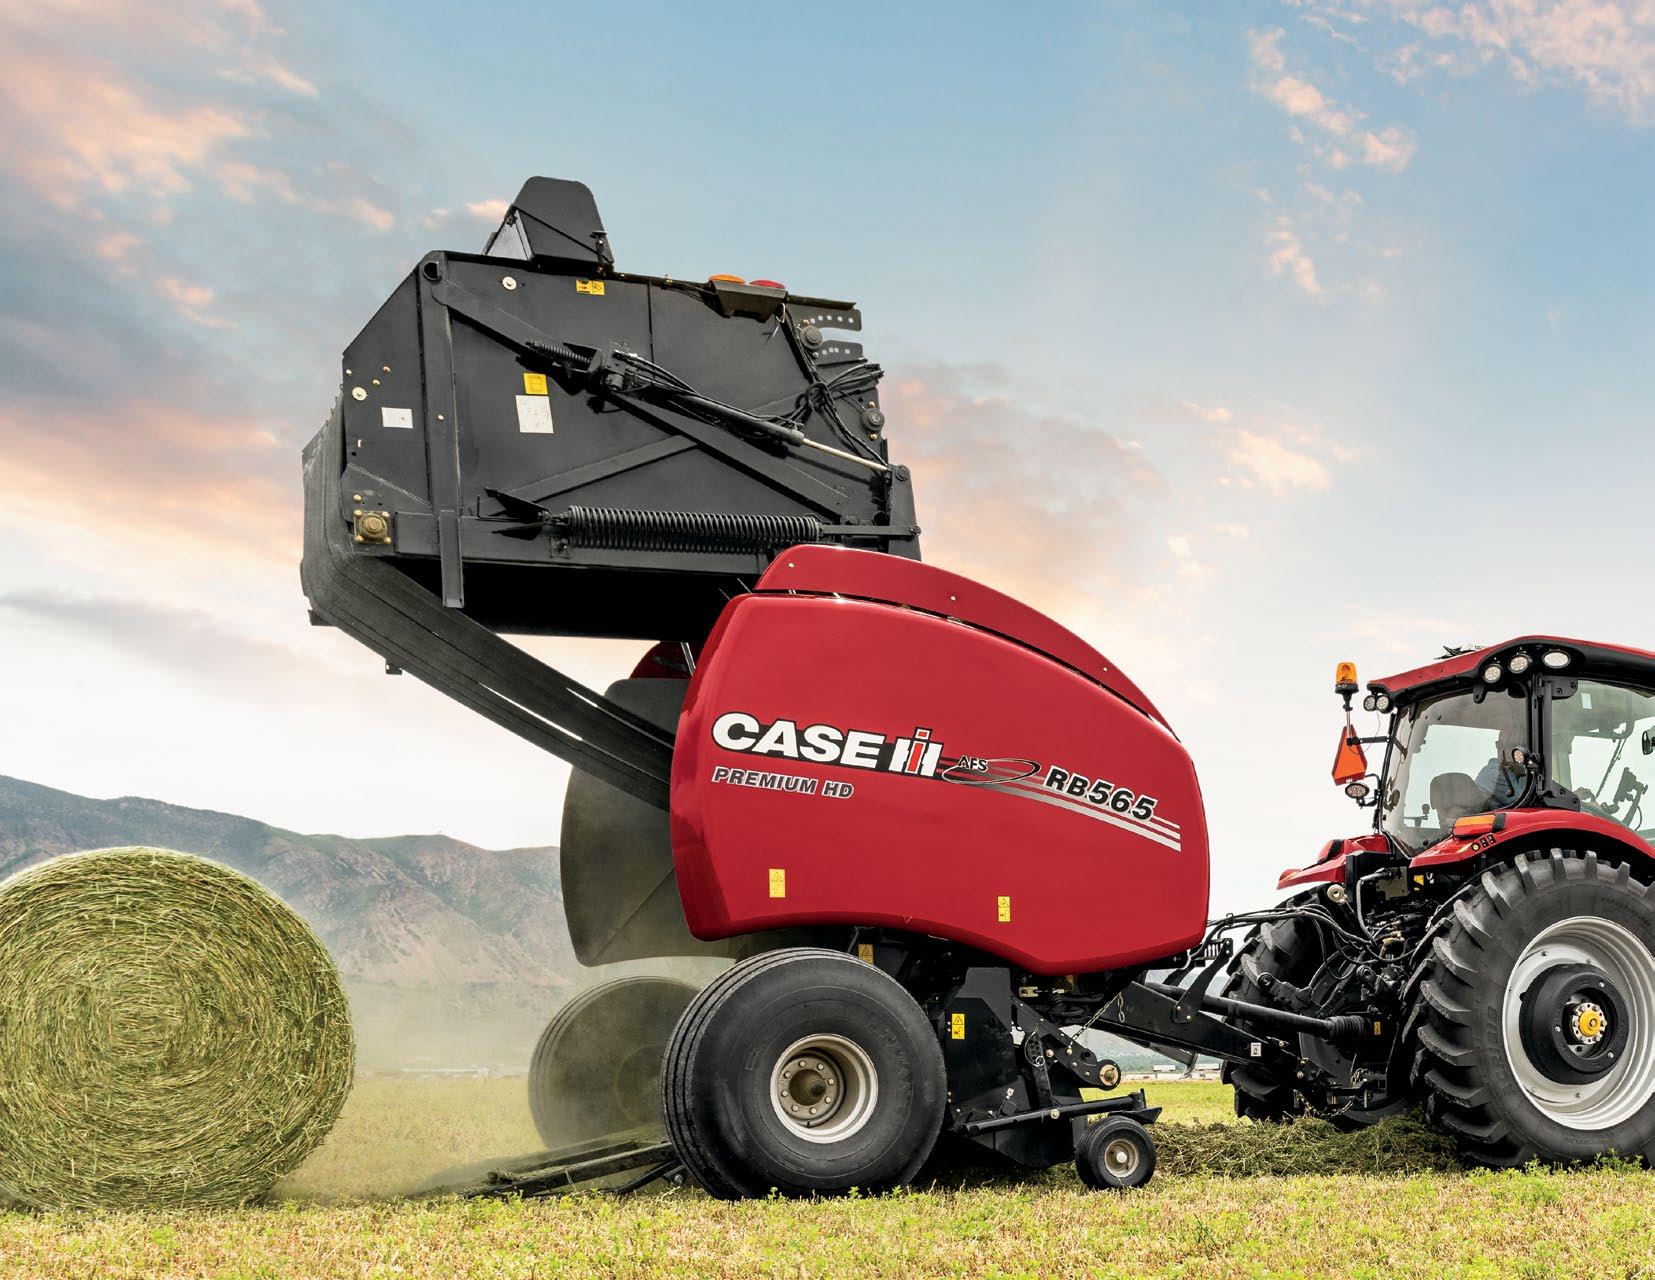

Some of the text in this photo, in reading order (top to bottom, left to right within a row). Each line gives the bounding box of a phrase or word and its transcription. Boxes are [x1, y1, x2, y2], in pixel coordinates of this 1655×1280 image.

[711, 711, 885, 769] CASE
[711, 766, 854, 798] PREMIUM HD
[957, 755, 988, 772] AFS
[1043, 765, 1158, 821] RB565
